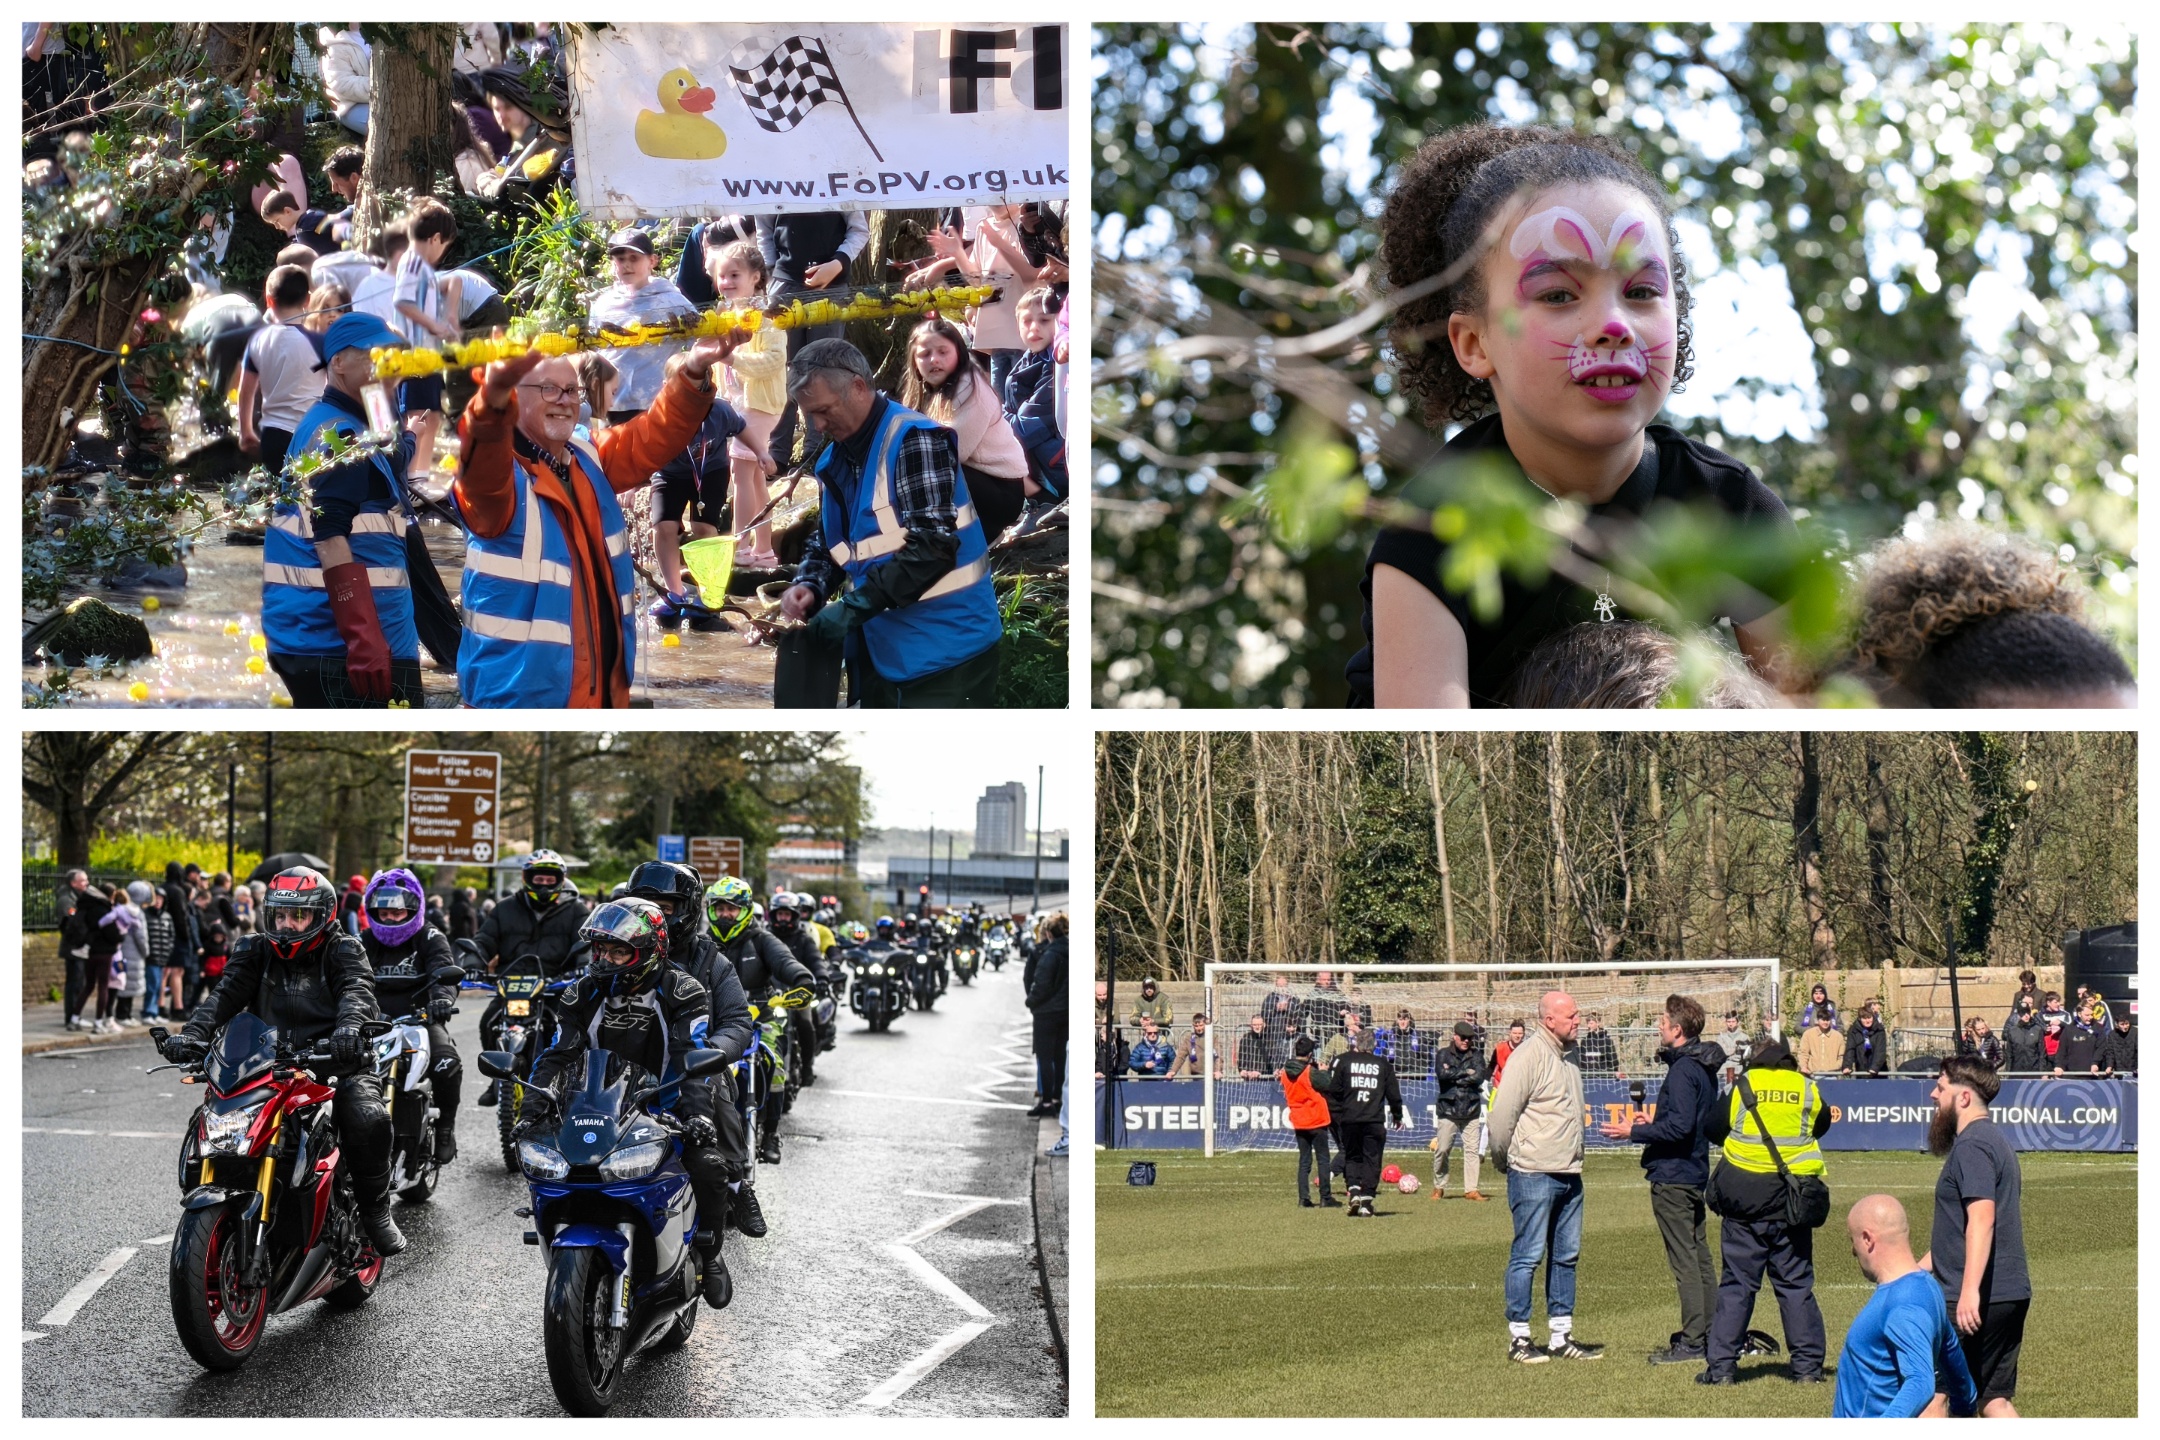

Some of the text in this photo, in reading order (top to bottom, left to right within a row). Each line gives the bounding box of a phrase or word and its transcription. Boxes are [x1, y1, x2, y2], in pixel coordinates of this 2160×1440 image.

[950, 25, 1063, 114] FI
[722, 163, 1069, 198] www.FoPV.org.uk
[437, 755, 470, 766] Follow
[413, 766, 494, 779] Heart of the City
[445, 777, 460, 786] for
[410, 792, 451, 803] Crucible
[412, 803, 448, 814] Lyceum
[410, 816, 461, 827] Millennium
[413, 826, 457, 838] Galleries
[409, 843, 471, 856] Bramall Lane
[1351, 1063, 1380, 1075] NAGS
[1351, 1076, 1378, 1089] HEAD
[1357, 1090, 1370, 1102] FC
[1757, 1091, 1799, 1103] BBC
[1124, 1105, 1217, 1130] STEEL
[1847, 1106, 2118, 1125] MEPSINTTIONAL.COM
[574, 1118, 605, 1127] YAMAHA
